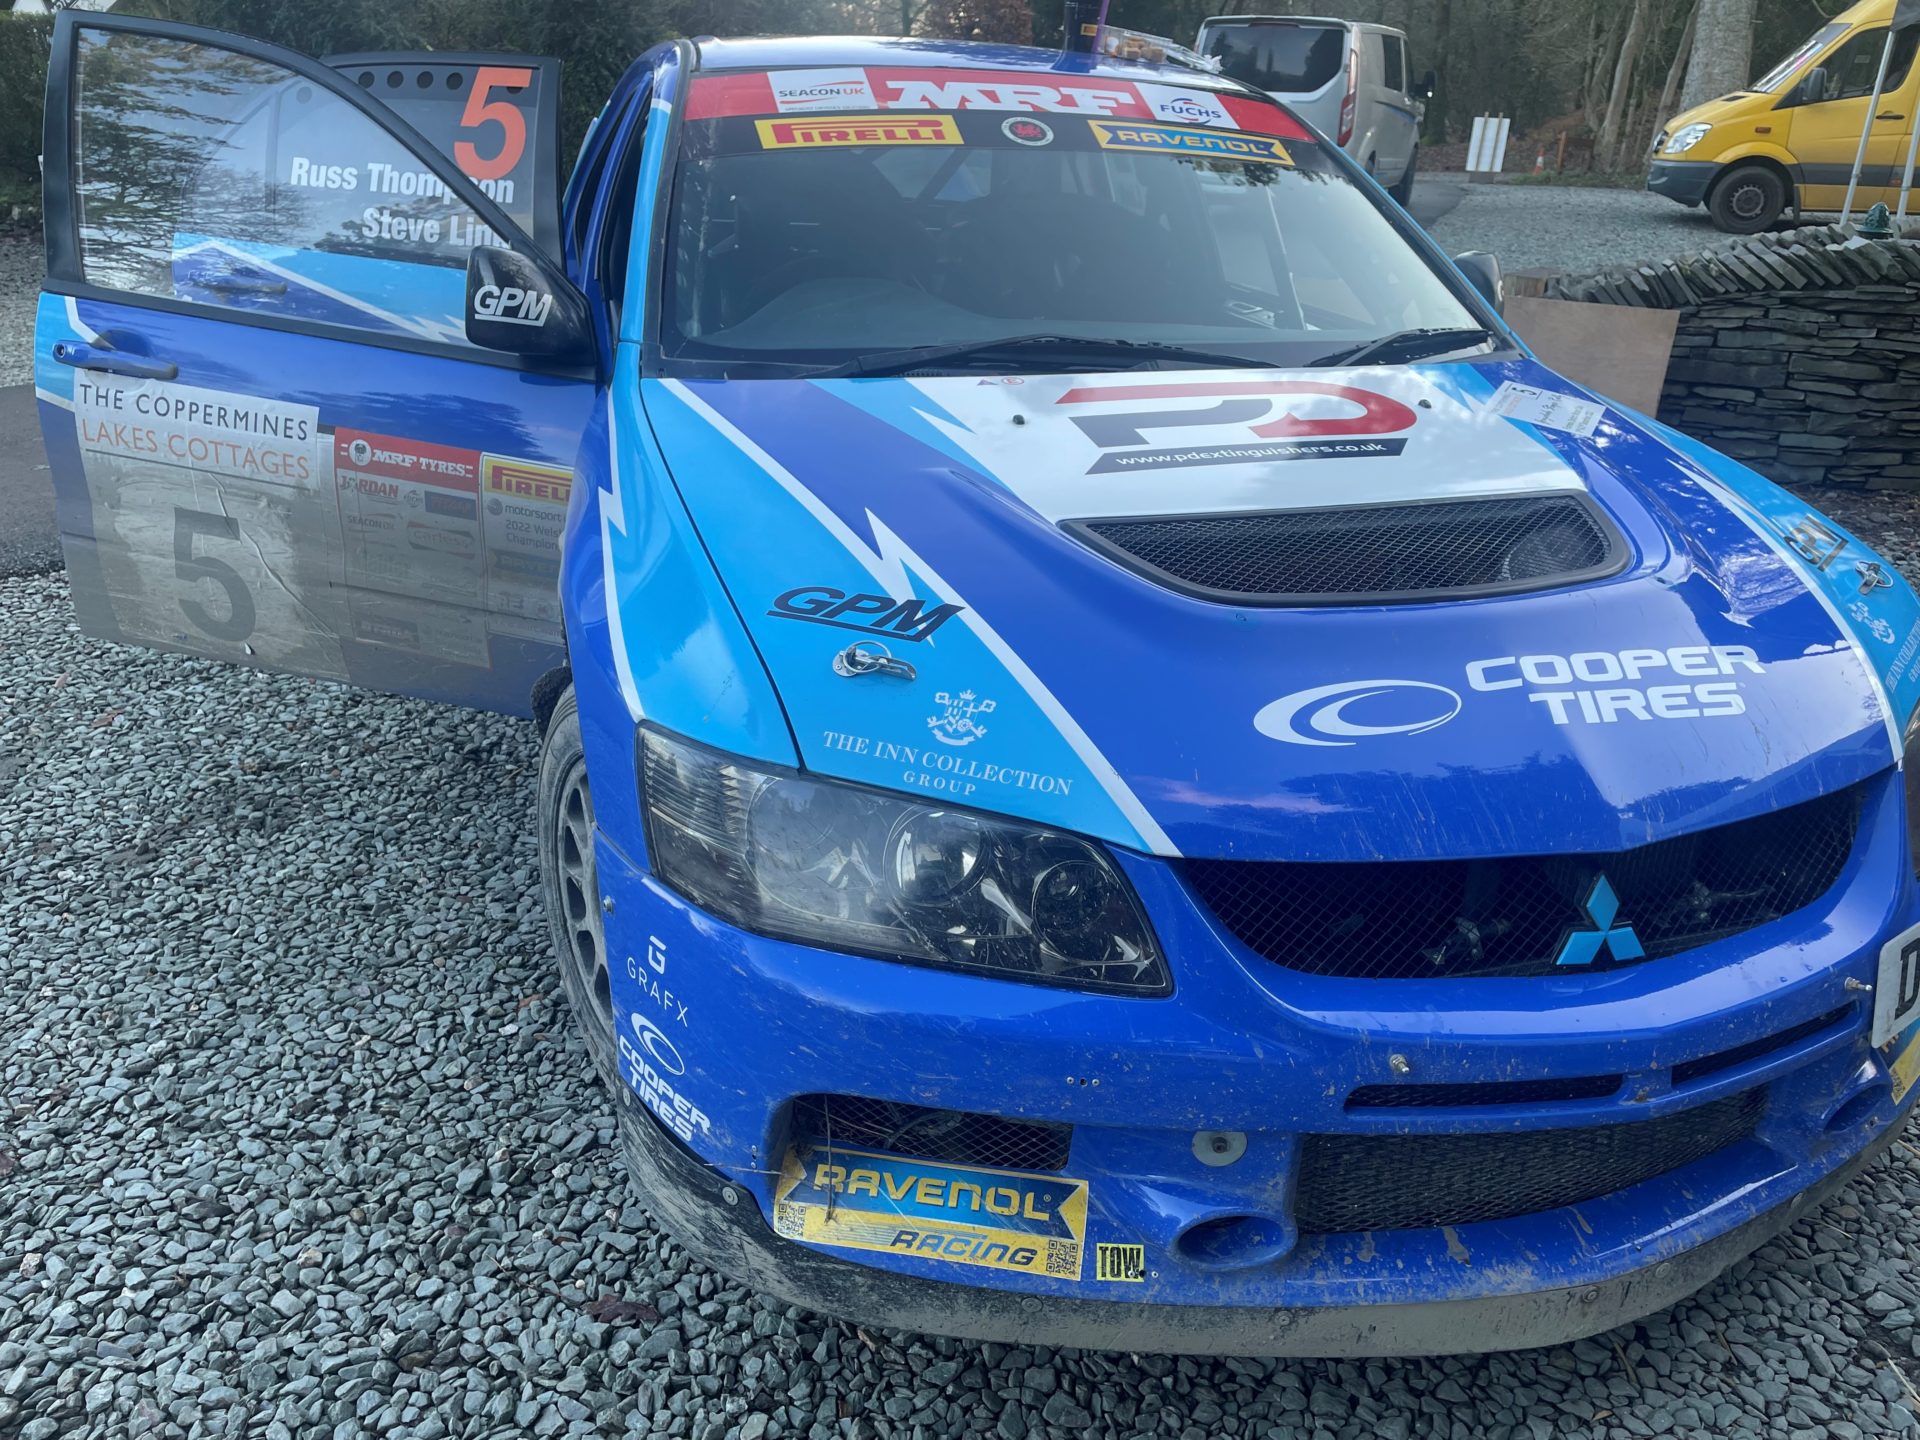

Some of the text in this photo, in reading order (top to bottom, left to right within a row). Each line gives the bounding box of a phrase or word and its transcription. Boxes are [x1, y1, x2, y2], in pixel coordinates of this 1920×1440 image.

[779, 87, 864, 97] SEACON UK
[886, 81, 1136, 115] MRF
[1160, 104, 1222, 119] FUCHS
[454, 67, 532, 180] 5
[772, 120, 946, 144] PIRELLI
[1116, 130, 1270, 154] RAVENOL
[290, 156, 514, 205] Russ Thompon
[362, 207, 440, 243] Steve
[474, 284, 552, 327] GPM
[80, 383, 308, 441] THE COPPERMINES
[82, 418, 310, 480] LAKES COTTAGES
[372, 448, 466, 478] MRF TYRES
[1116, 443, 1387, 466] www.pdextinguishers.co.uk
[492, 465, 571, 502] PIREL
[505, 504, 562, 522] motorsport
[506, 532, 562, 552] Champion
[173, 506, 256, 643] 5
[766, 586, 967, 643] GPM
[1465, 645, 1767, 692] COOPER
[1528, 682, 1747, 724] TIRES
[823, 730, 1073, 797] THE INN COLLECTION
[903, 770, 976, 797] GROUP
[627, 956, 688, 1028] GRAFX
[619, 1035, 711, 1134] COOPER
[629, 1065, 695, 1142] TIRES
[813, 1163, 1050, 1221] RAVENOL
[889, 1230, 1038, 1267] RACING
[1099, 1245, 1142, 1279] TOW
